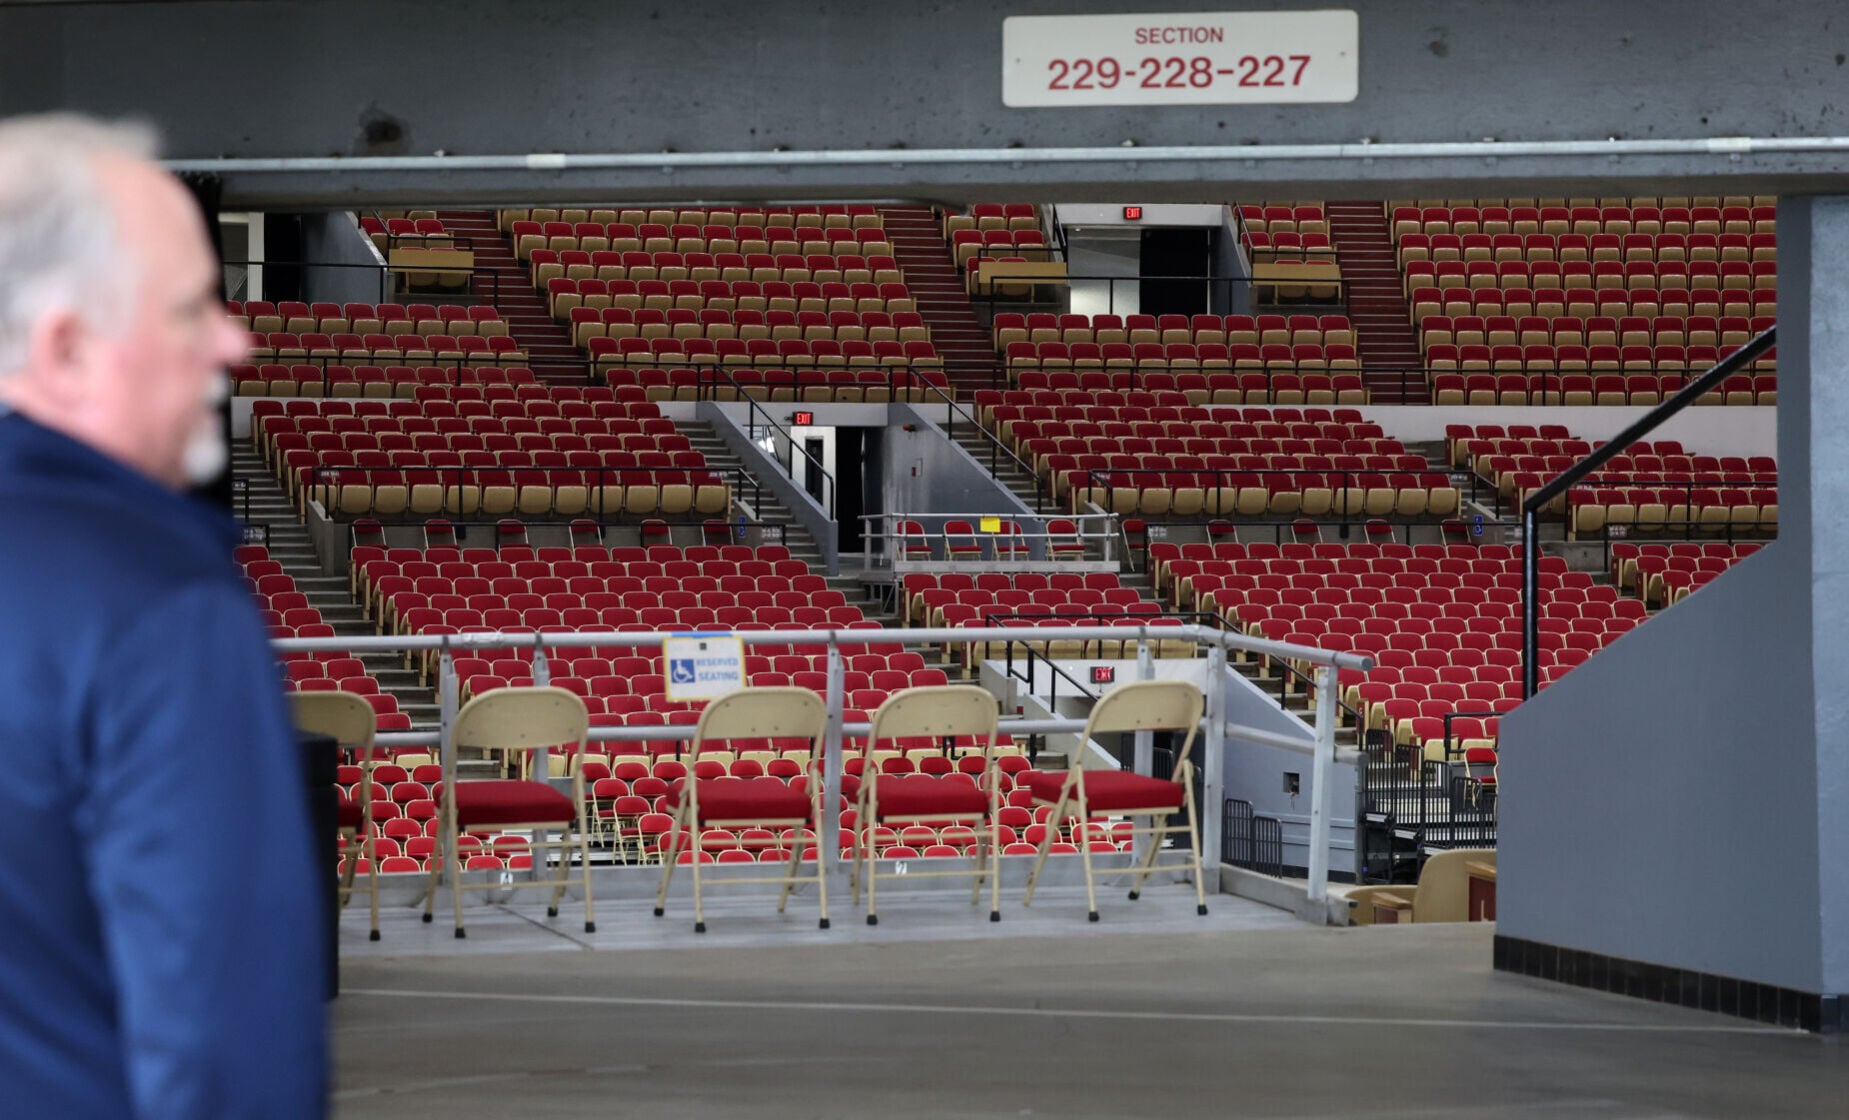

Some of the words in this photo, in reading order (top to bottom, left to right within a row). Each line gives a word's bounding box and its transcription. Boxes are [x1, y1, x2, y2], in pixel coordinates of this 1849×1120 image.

[1135, 27, 1224, 44] SECTION
[1048, 55, 1311, 90] 229-228-227
[1126, 207, 1140, 219] EXIT
[797, 412, 811, 425] EXIT
[696, 658, 738, 666] RESERVED
[698, 672, 738, 680] SEATING
